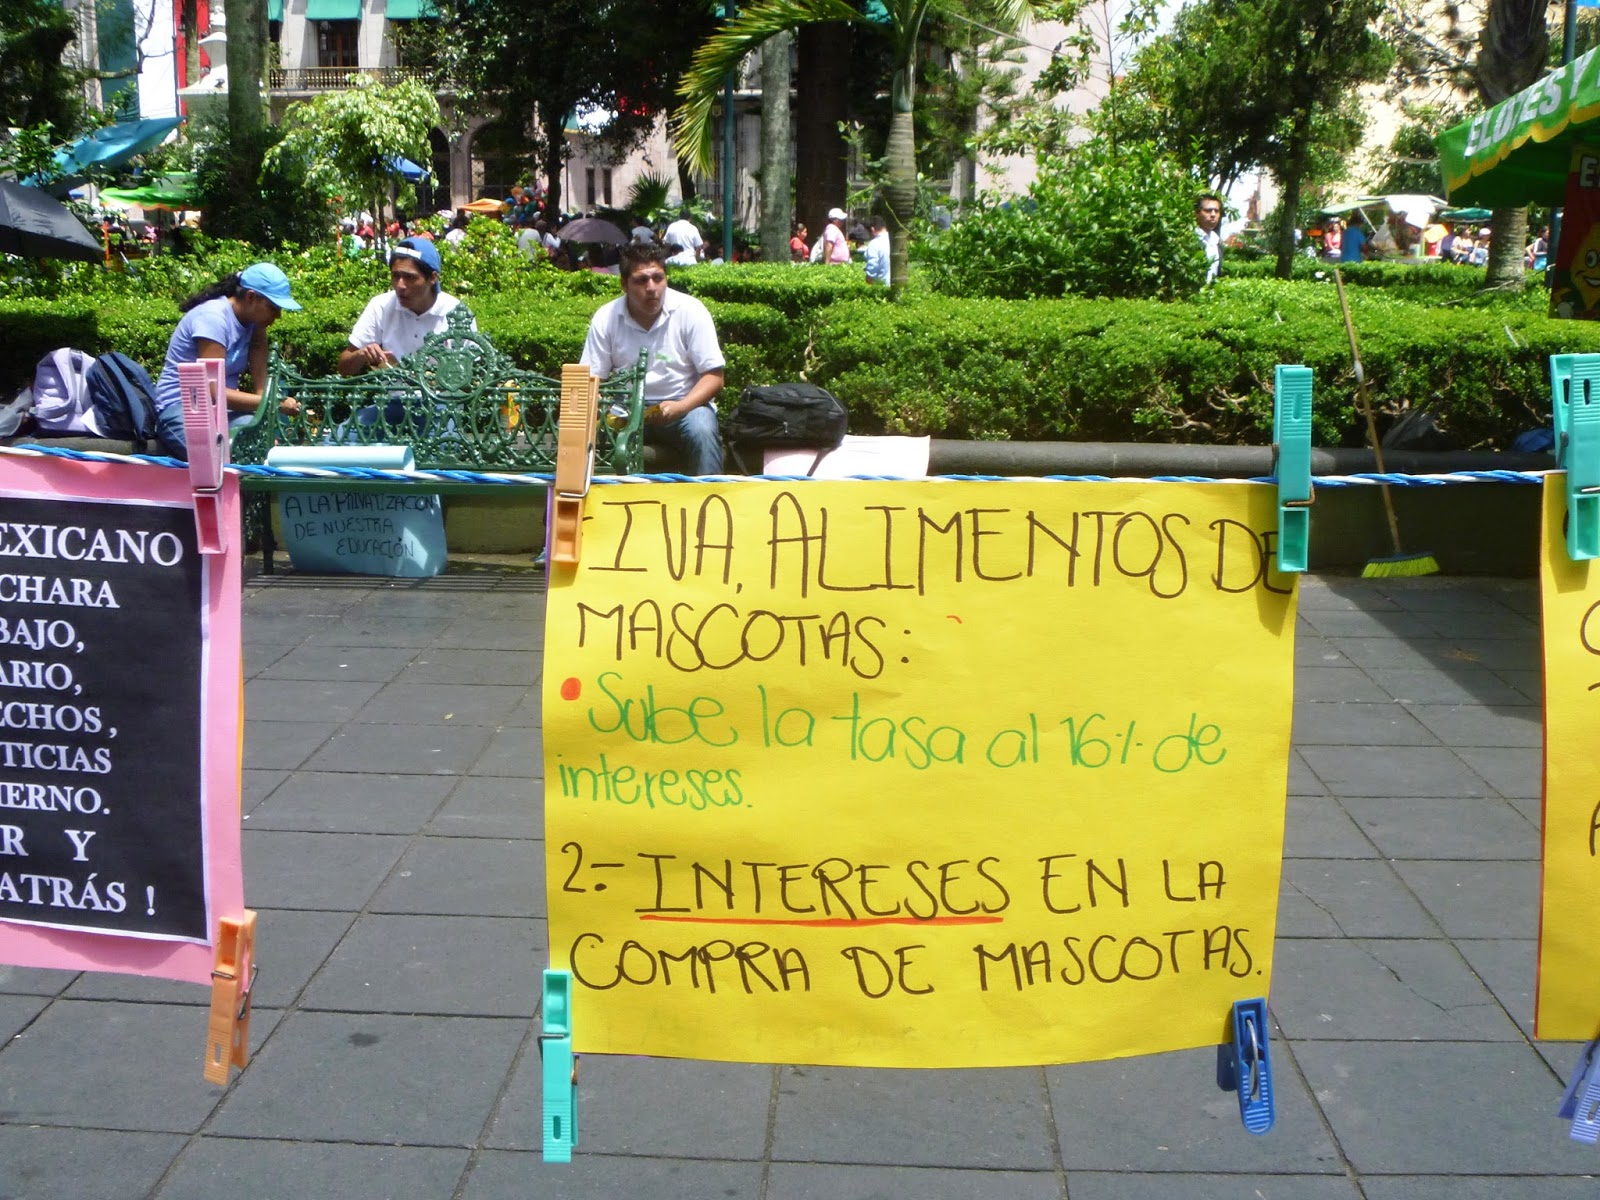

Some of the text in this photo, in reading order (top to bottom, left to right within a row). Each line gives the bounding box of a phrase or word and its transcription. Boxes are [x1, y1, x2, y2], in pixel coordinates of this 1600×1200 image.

[285, 496, 302, 518] A
[309, 496, 331, 514] LA
[294, 517, 394, 540] DE NUESTRA
[588, 491, 1293, 599] IVA, ALIMENTOS DE
[0, 573, 121, 609] CHARA
[577, 599, 911, 680] MASCOTAS:
[588, 672, 738, 747] Sube
[757, 684, 816, 748] la
[831, 692, 966, 770] tasa
[986, 713, 1039, 768] al
[1153, 713, 1227, 773] de
[0, 741, 112, 774] TICIAS
[557, 753, 753, 811] intereses.
[64, 829, 97, 862] Y
[0, 872, 126, 913] ATRÁS
[635, 852, 1011, 921] INTERESES
[1038, 853, 1130, 914] EN
[1162, 860, 1227, 902] LA
[570, 925, 1263, 999] COMPRA DE MASCOTAS.
